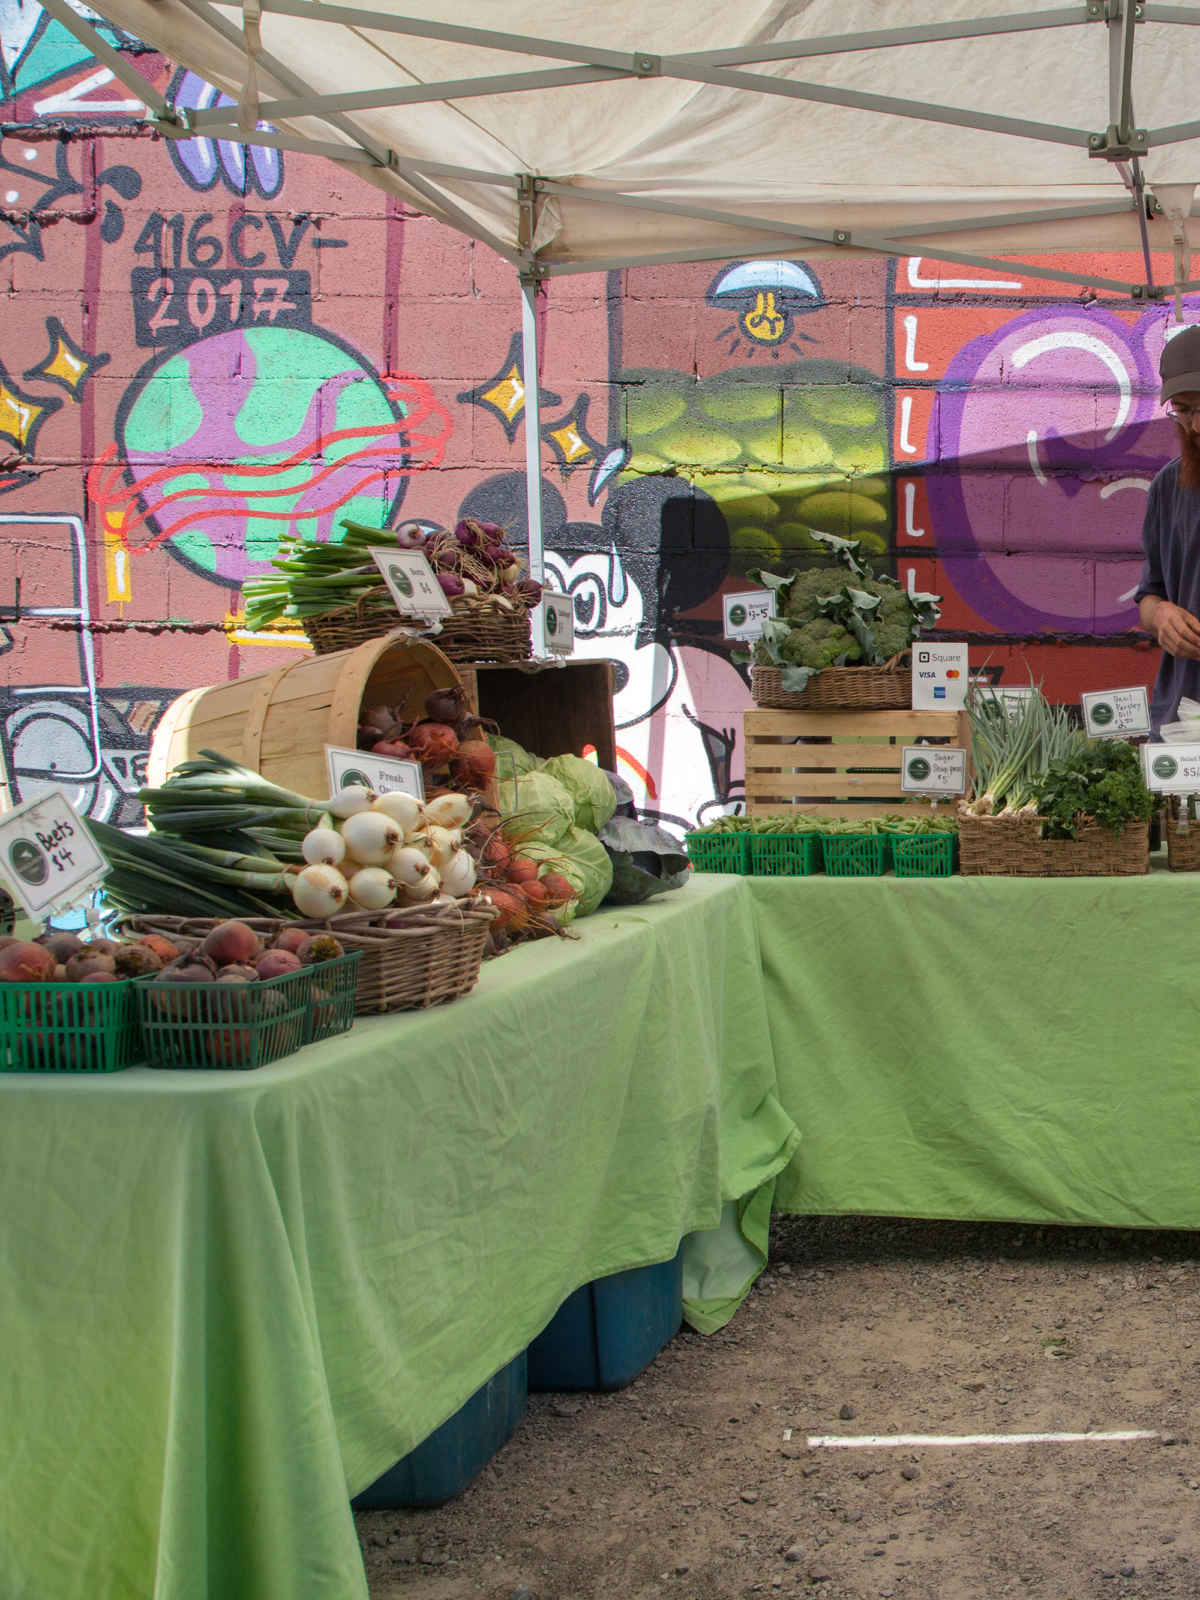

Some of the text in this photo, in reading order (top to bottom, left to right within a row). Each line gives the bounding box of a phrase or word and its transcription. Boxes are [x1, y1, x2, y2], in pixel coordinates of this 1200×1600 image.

[147, 277, 298, 338] 2017
[932, 653, 961, 665] Square
[918, 671, 937, 680] VISA
[35, 819, 75, 852] Beets
[52, 847, 75, 872] $4
